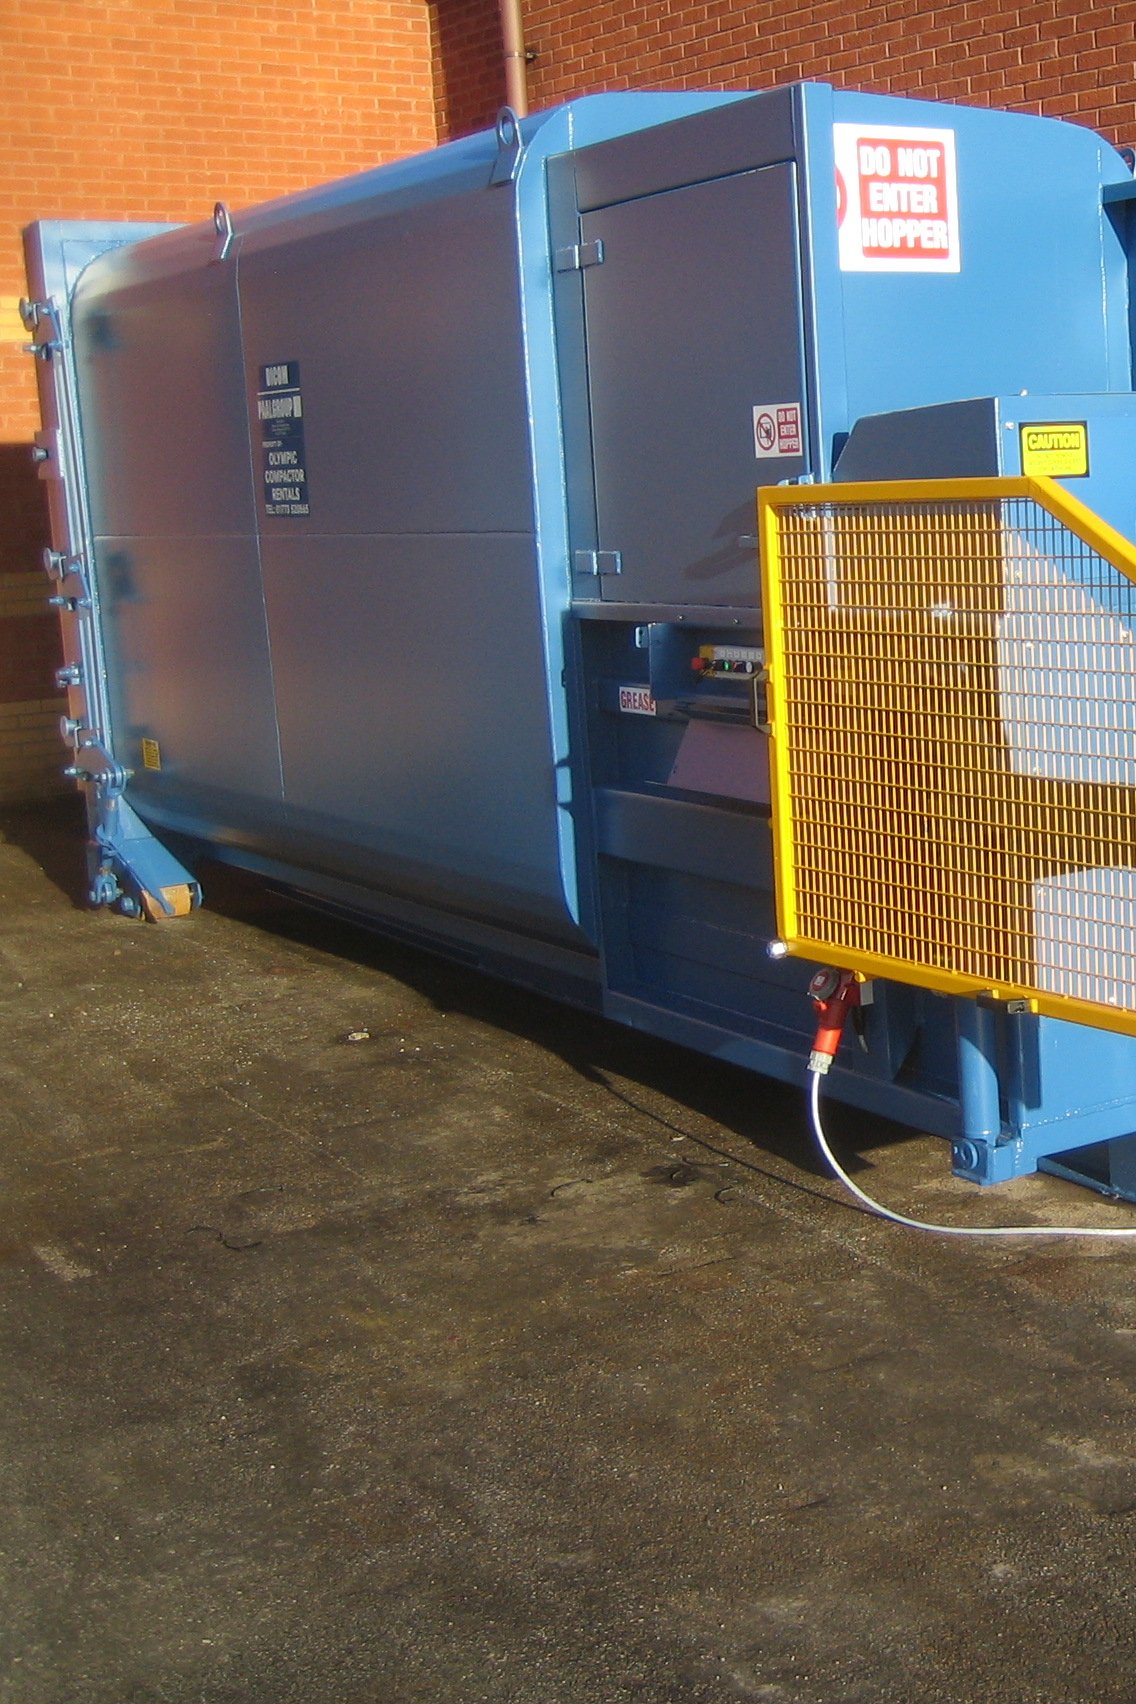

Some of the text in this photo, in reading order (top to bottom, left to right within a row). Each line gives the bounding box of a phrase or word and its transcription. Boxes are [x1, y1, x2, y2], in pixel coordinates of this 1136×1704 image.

[858, 145, 941, 179] DO NOT
[868, 181, 939, 214] ENTER
[861, 217, 949, 250] HOPPER
[777, 409, 797, 423] DO NOT
[780, 424, 797, 437] ENTER
[779, 438, 800, 451] HOPPER
[1028, 432, 1080, 450] CAUTION
[268, 450, 298, 466] OLYMPIC
[264, 468, 305, 484] COMPACTOR
[271, 487, 301, 501] RENTALS
